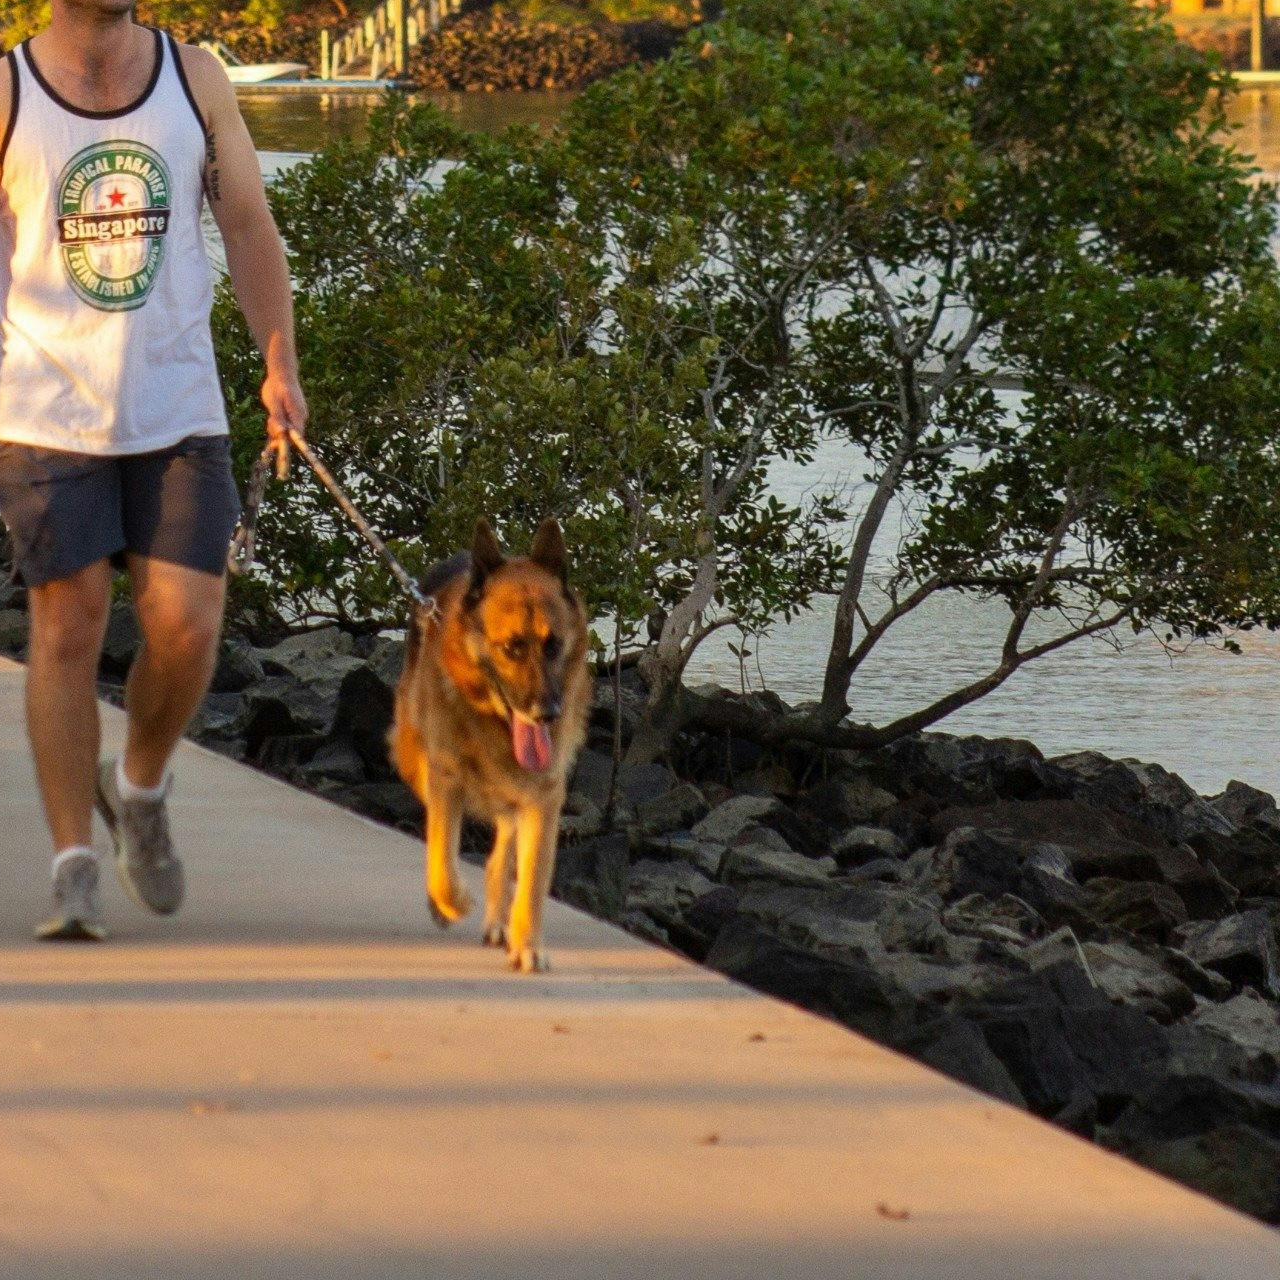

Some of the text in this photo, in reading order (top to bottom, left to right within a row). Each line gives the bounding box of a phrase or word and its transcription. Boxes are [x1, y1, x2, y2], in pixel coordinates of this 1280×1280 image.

[63, 158, 111, 204] TROPICAL
[115, 155, 167, 199] PARADISE
[63, 216, 165, 240] Singapore
[69, 251, 135, 297] ESTABLISHED
